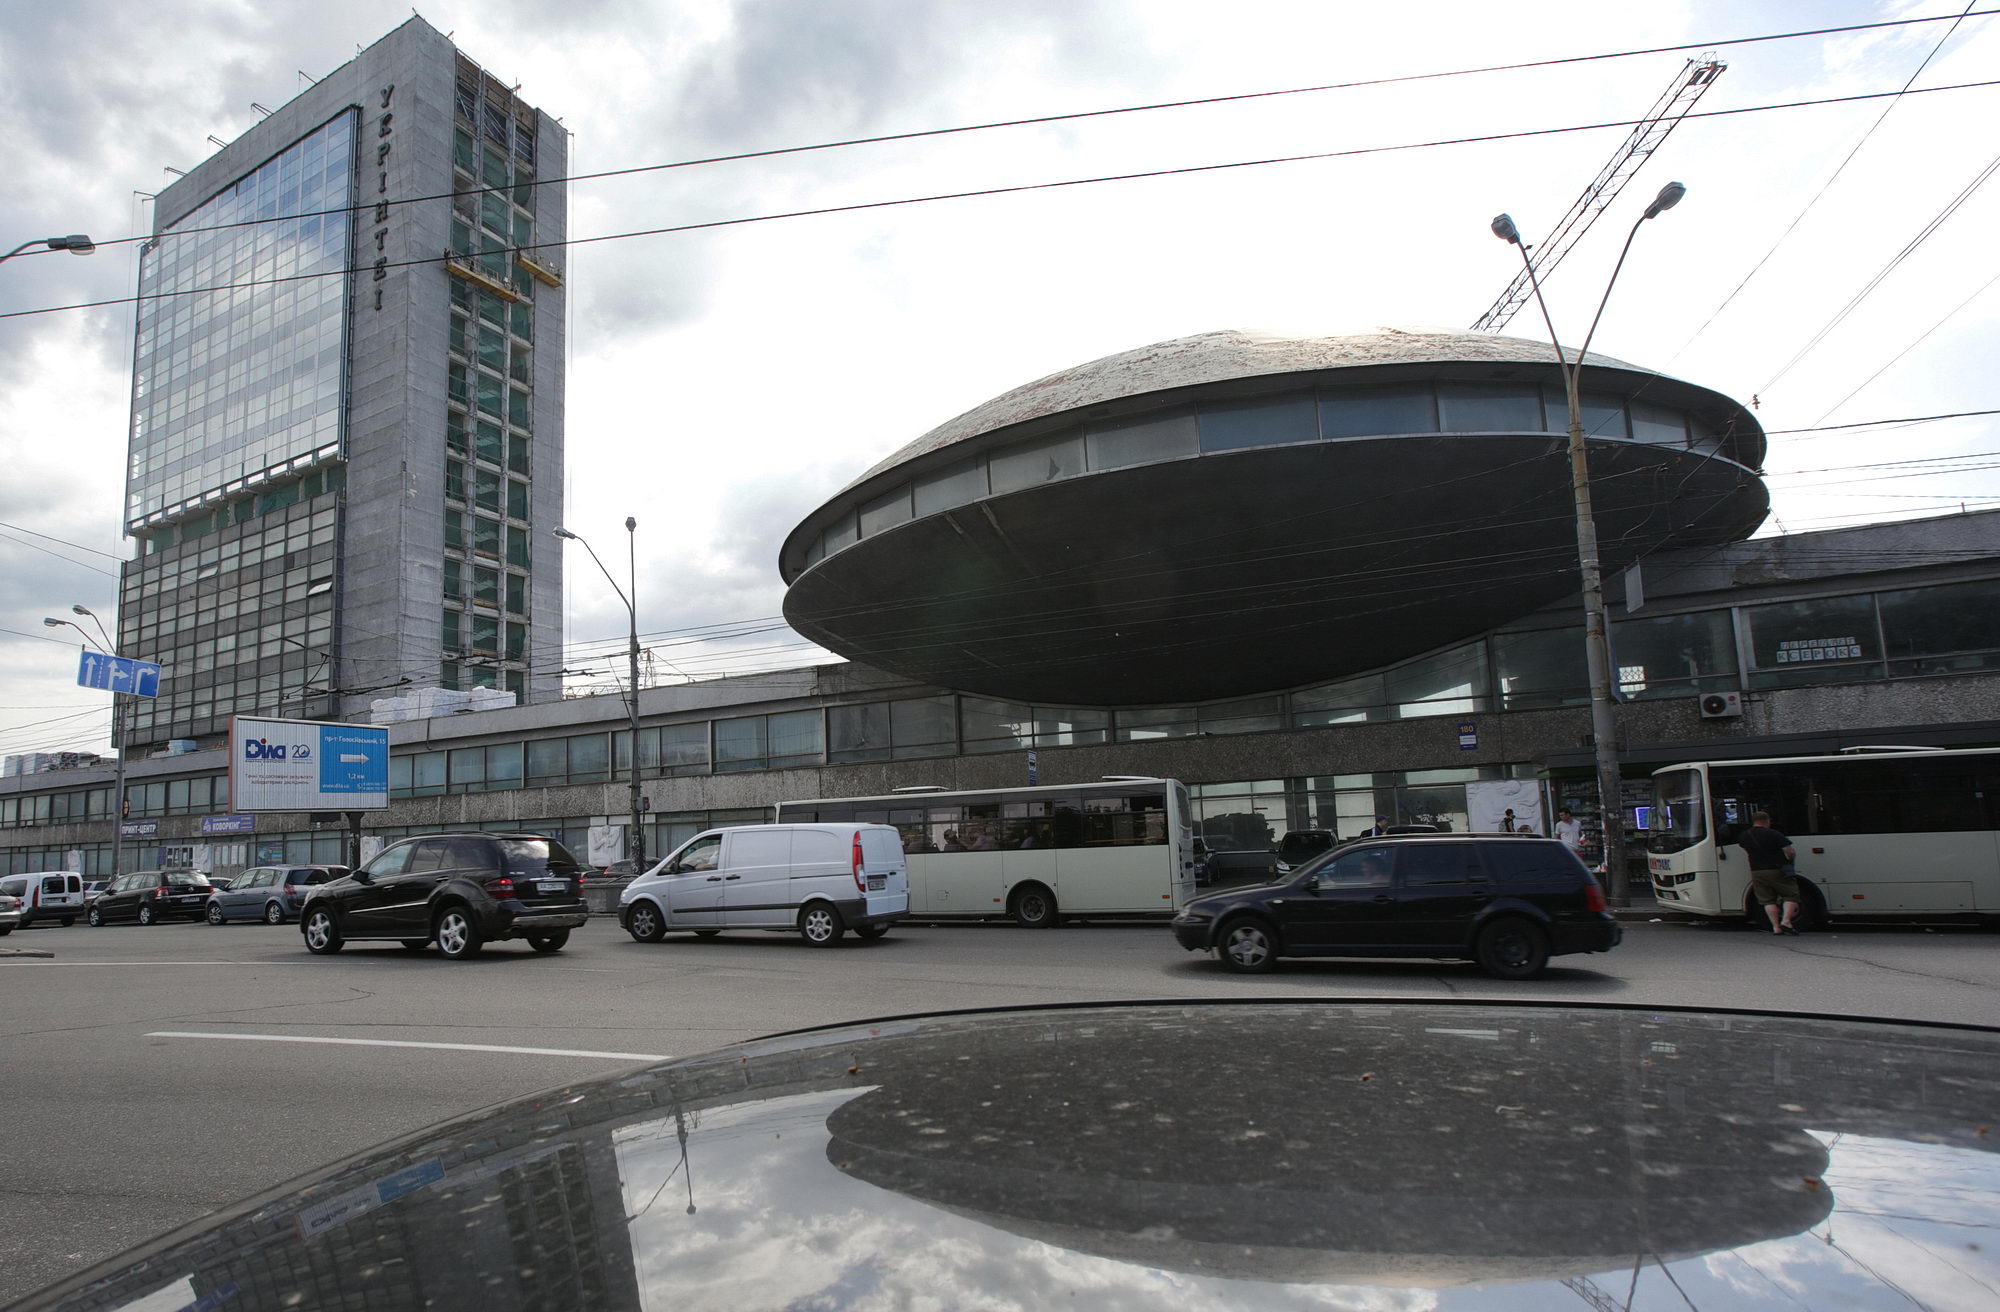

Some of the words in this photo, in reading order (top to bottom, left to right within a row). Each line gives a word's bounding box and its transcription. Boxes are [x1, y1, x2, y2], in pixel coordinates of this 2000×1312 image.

[373, 84, 395, 311] УКРІНТЕІ
[1777, 646, 1861, 660] КСЕРОКС
[292, 744, 310, 758] 20
[121, 823, 157, 835] ПРИНТ-ЦЕНТР
